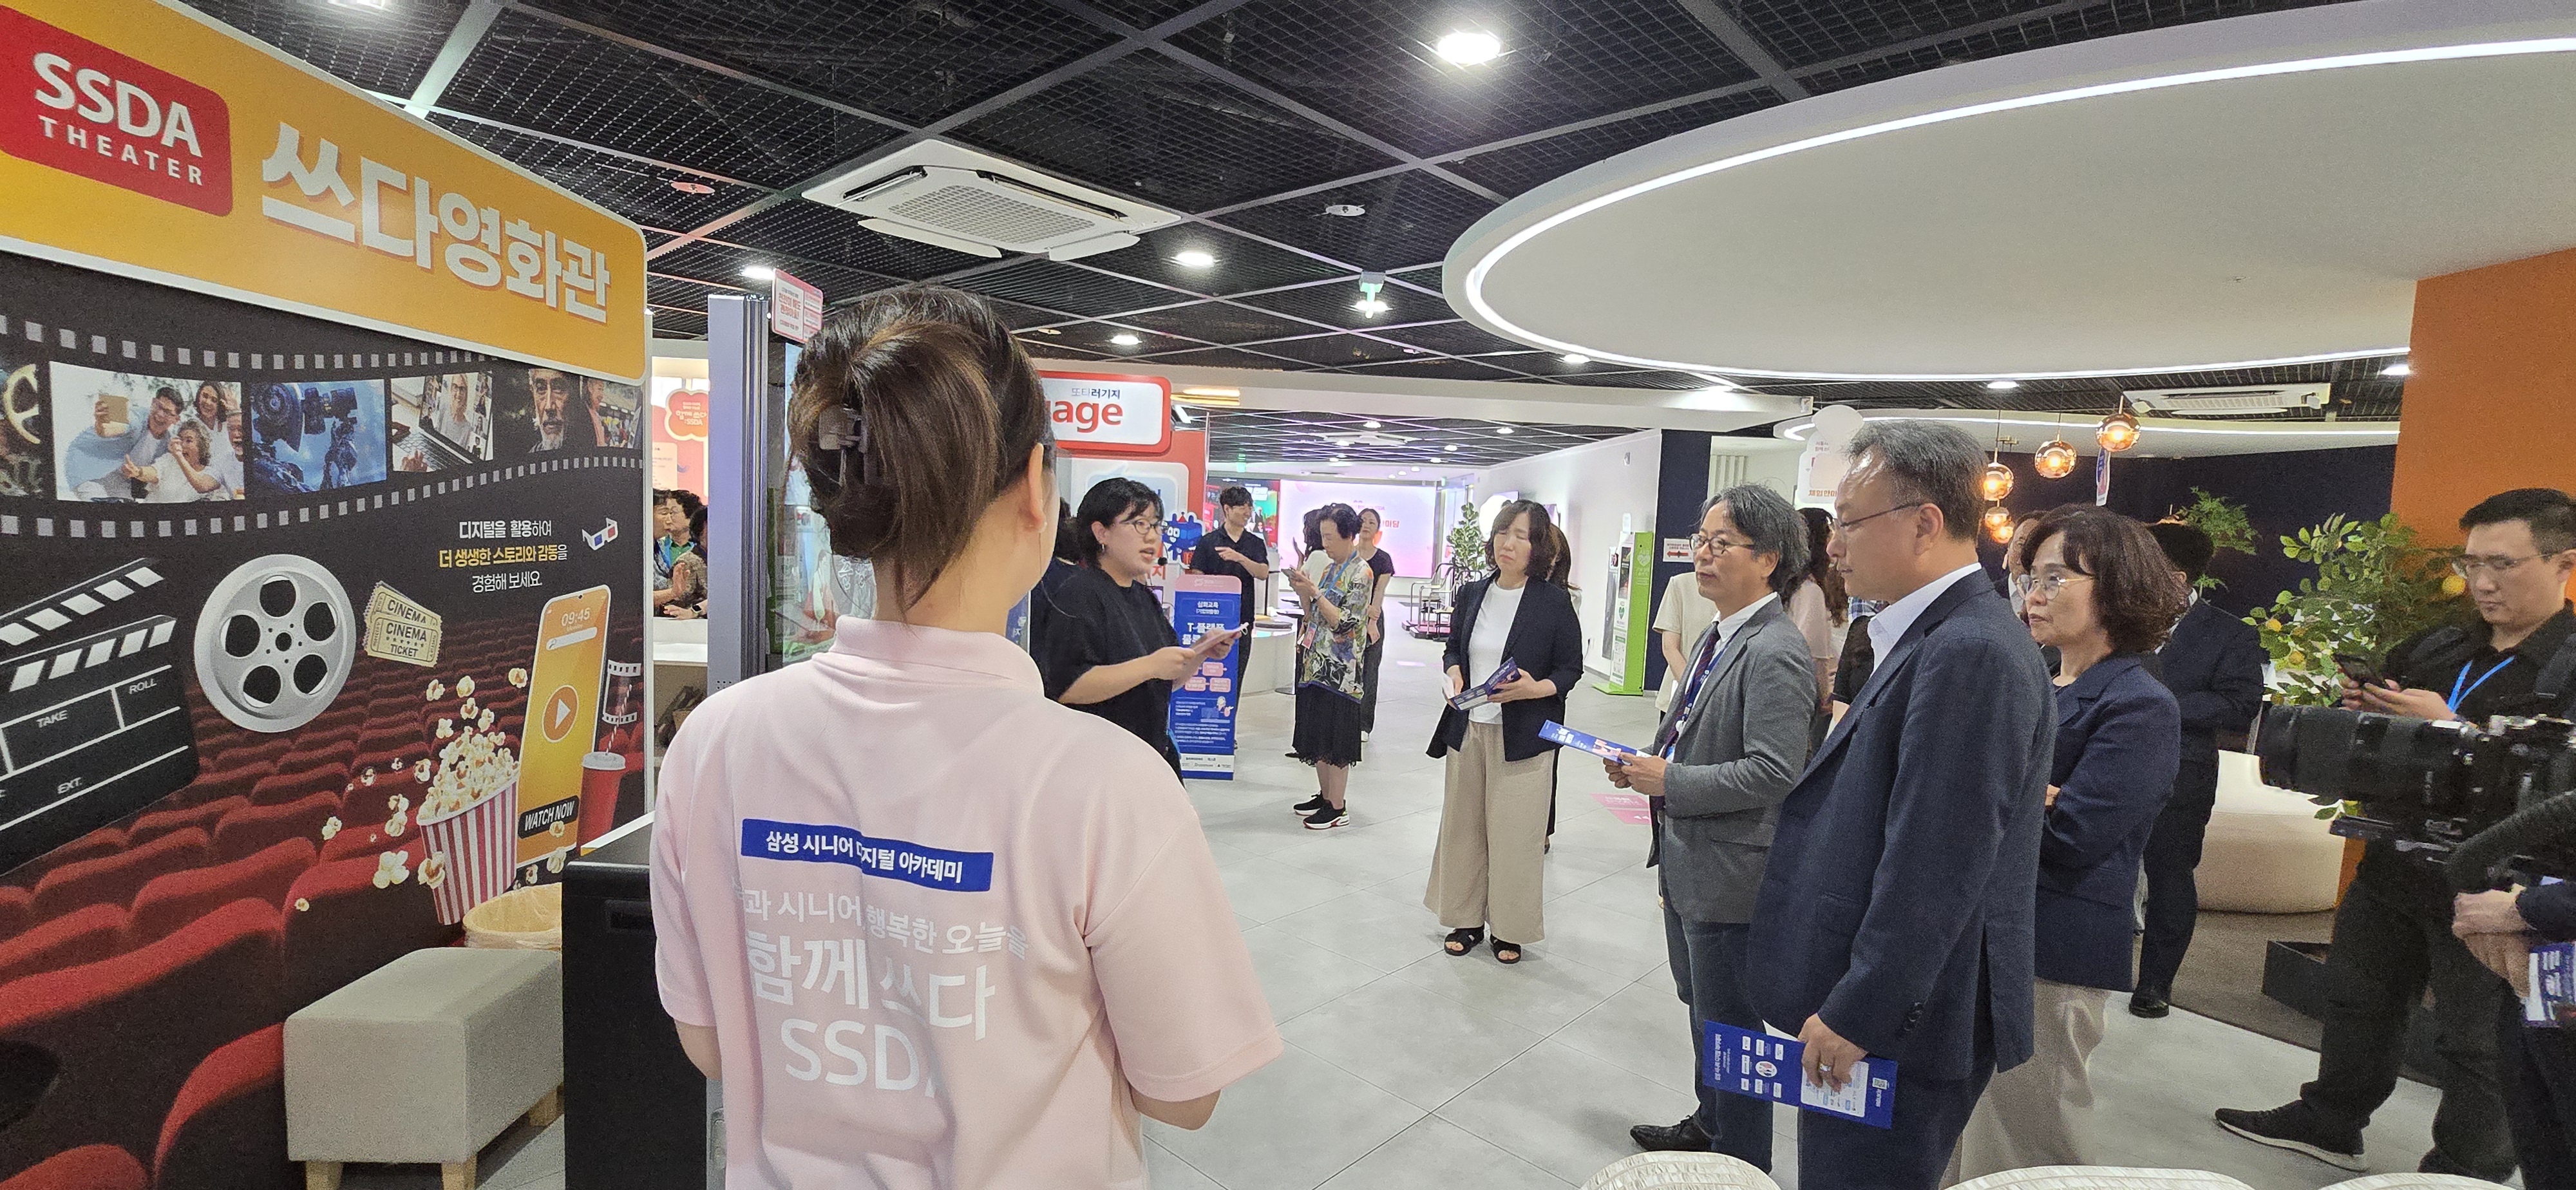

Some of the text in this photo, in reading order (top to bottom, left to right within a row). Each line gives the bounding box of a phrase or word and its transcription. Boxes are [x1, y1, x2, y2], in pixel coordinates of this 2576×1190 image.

[33, 52, 203, 158] SSDA
[38, 115, 203, 186] THEATER
[261, 121, 611, 323] 쓰다영화관
[1071, 388, 1121, 399] 또타러기지
[1046, 399, 1124, 433] age
[459, 520, 552, 540] 디지털을 활용하여
[439, 544, 568, 568] 더 생생한 스토리와 감동을
[472, 571, 542, 593] 경험해 보세요.
[387, 599, 426, 623] CINEMA
[561, 607, 591, 627] 09:45
[386, 622, 426, 642] CINEMA
[390, 644, 419, 657] TICKET
[129, 678, 157, 695] ROLL
[36, 710, 68, 728] TAKE
[57, 777, 82, 794] EXT.
[525, 800, 575, 831] WATCH NOW
[766, 831, 799, 854] 삼성
[802, 835, 853, 857] 시니어
[899, 852, 962, 883] 아카데미
[777, 891, 863, 927] 시니어
[867, 904, 937, 954] 행복한
[942, 921, 1029, 961] 오늘을
[745, 930, 996, 1042] 함께 쓰다
